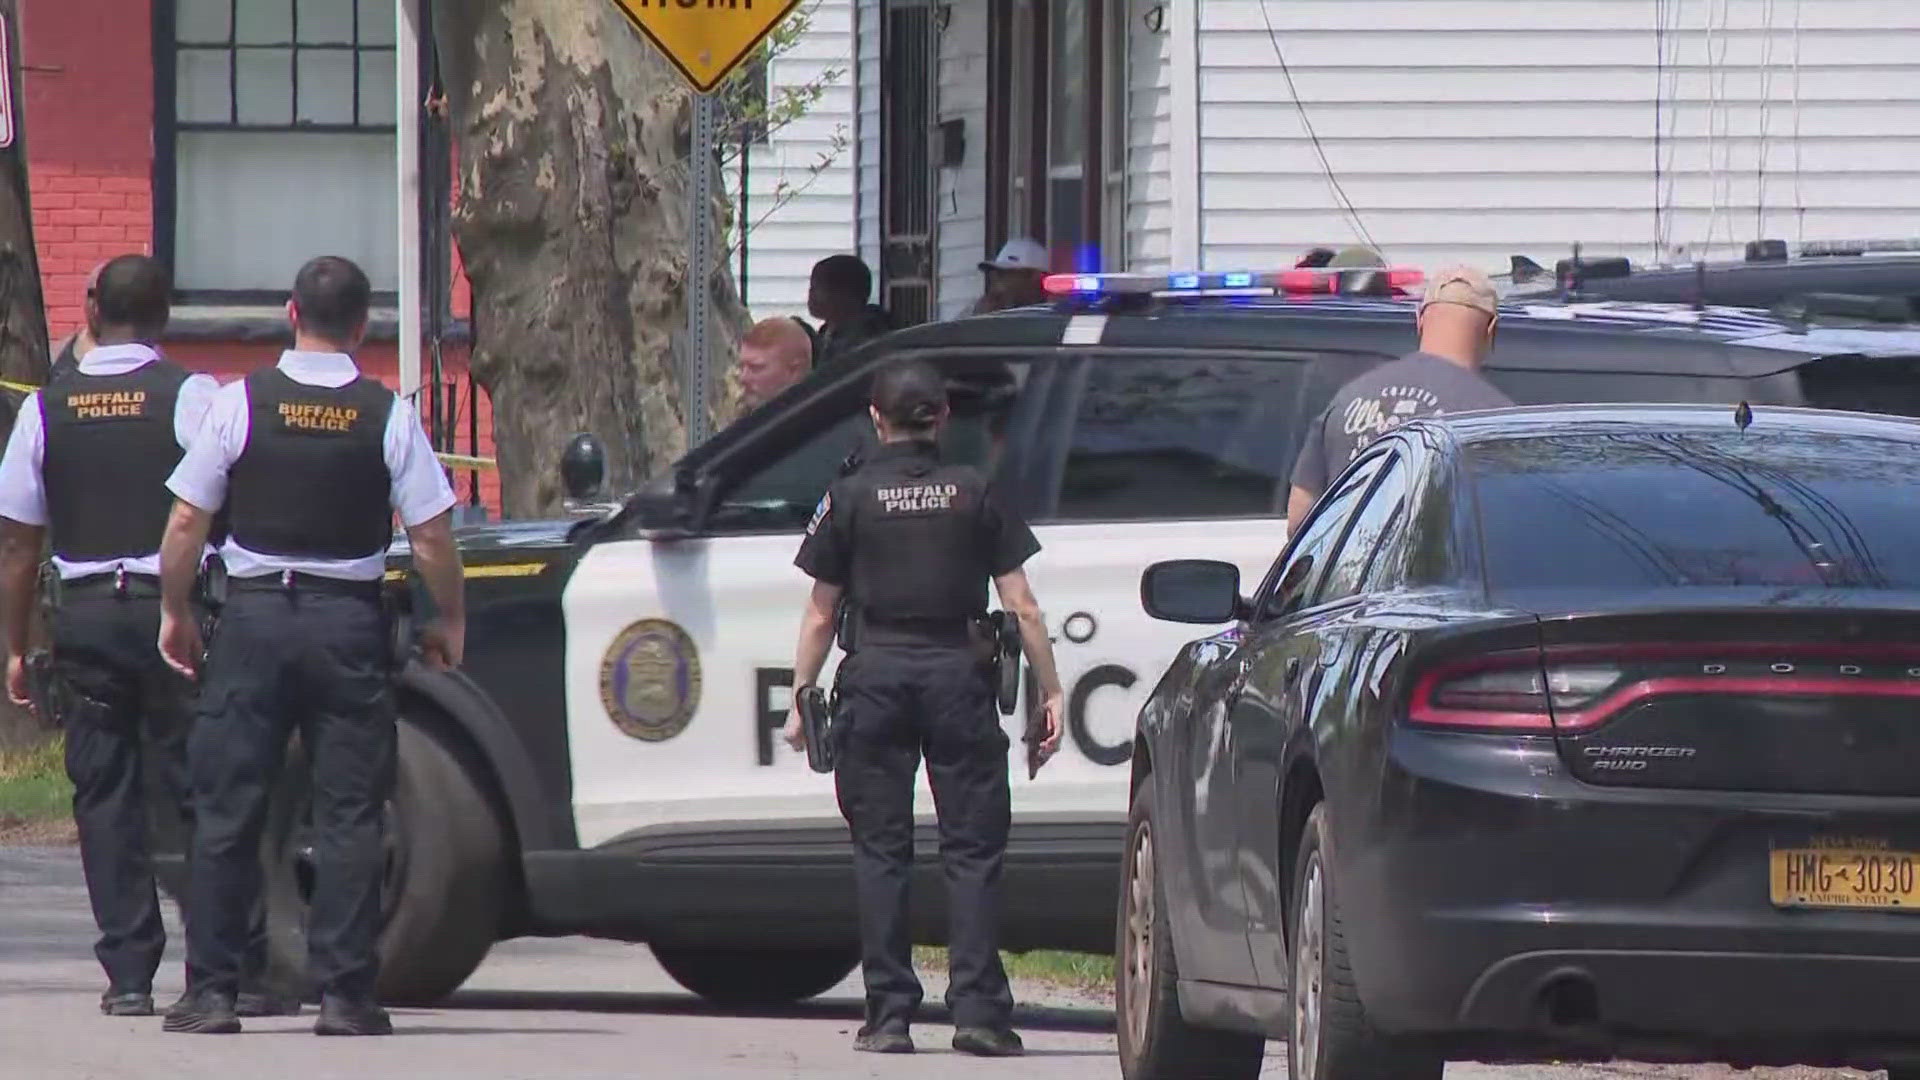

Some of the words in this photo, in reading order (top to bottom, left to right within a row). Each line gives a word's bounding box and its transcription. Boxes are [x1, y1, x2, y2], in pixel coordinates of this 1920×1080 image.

[67, 391, 146, 407] BUFFALO
[76, 404, 142, 419] POLICE
[278, 402, 358, 421] BUFFALO
[284, 415, 351, 432] POLICE
[877, 484, 958, 502] BUFFALO
[885, 496, 951, 513] POLICE
[1584, 746, 1697, 757] CHARGER
[1592, 759, 1648, 771] AWD
[1852, 855, 1914, 894] 3030
